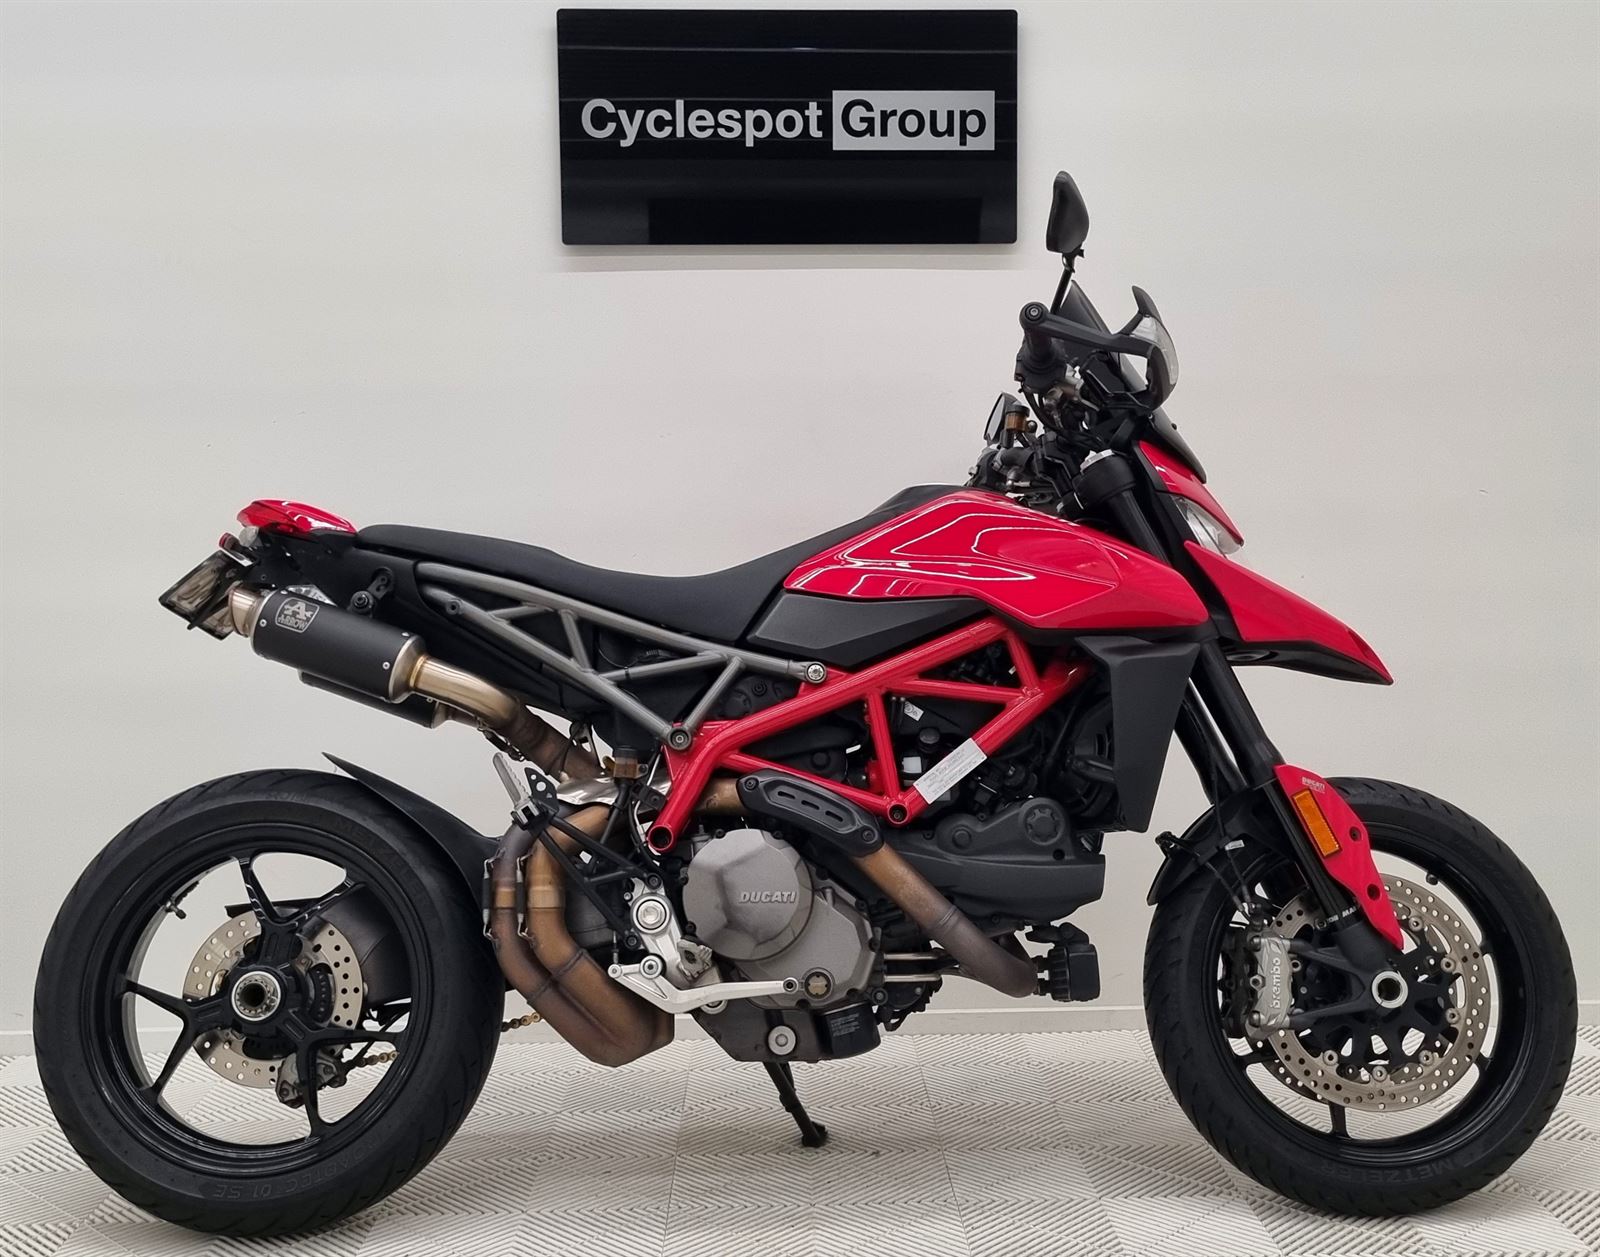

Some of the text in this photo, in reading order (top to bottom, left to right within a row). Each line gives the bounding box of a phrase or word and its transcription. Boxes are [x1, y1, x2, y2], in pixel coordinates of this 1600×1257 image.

[581, 99, 987, 147] Cyclespot Group
[739, 891, 796, 903] DUCATI
[1270, 957, 1281, 1009] brembo
